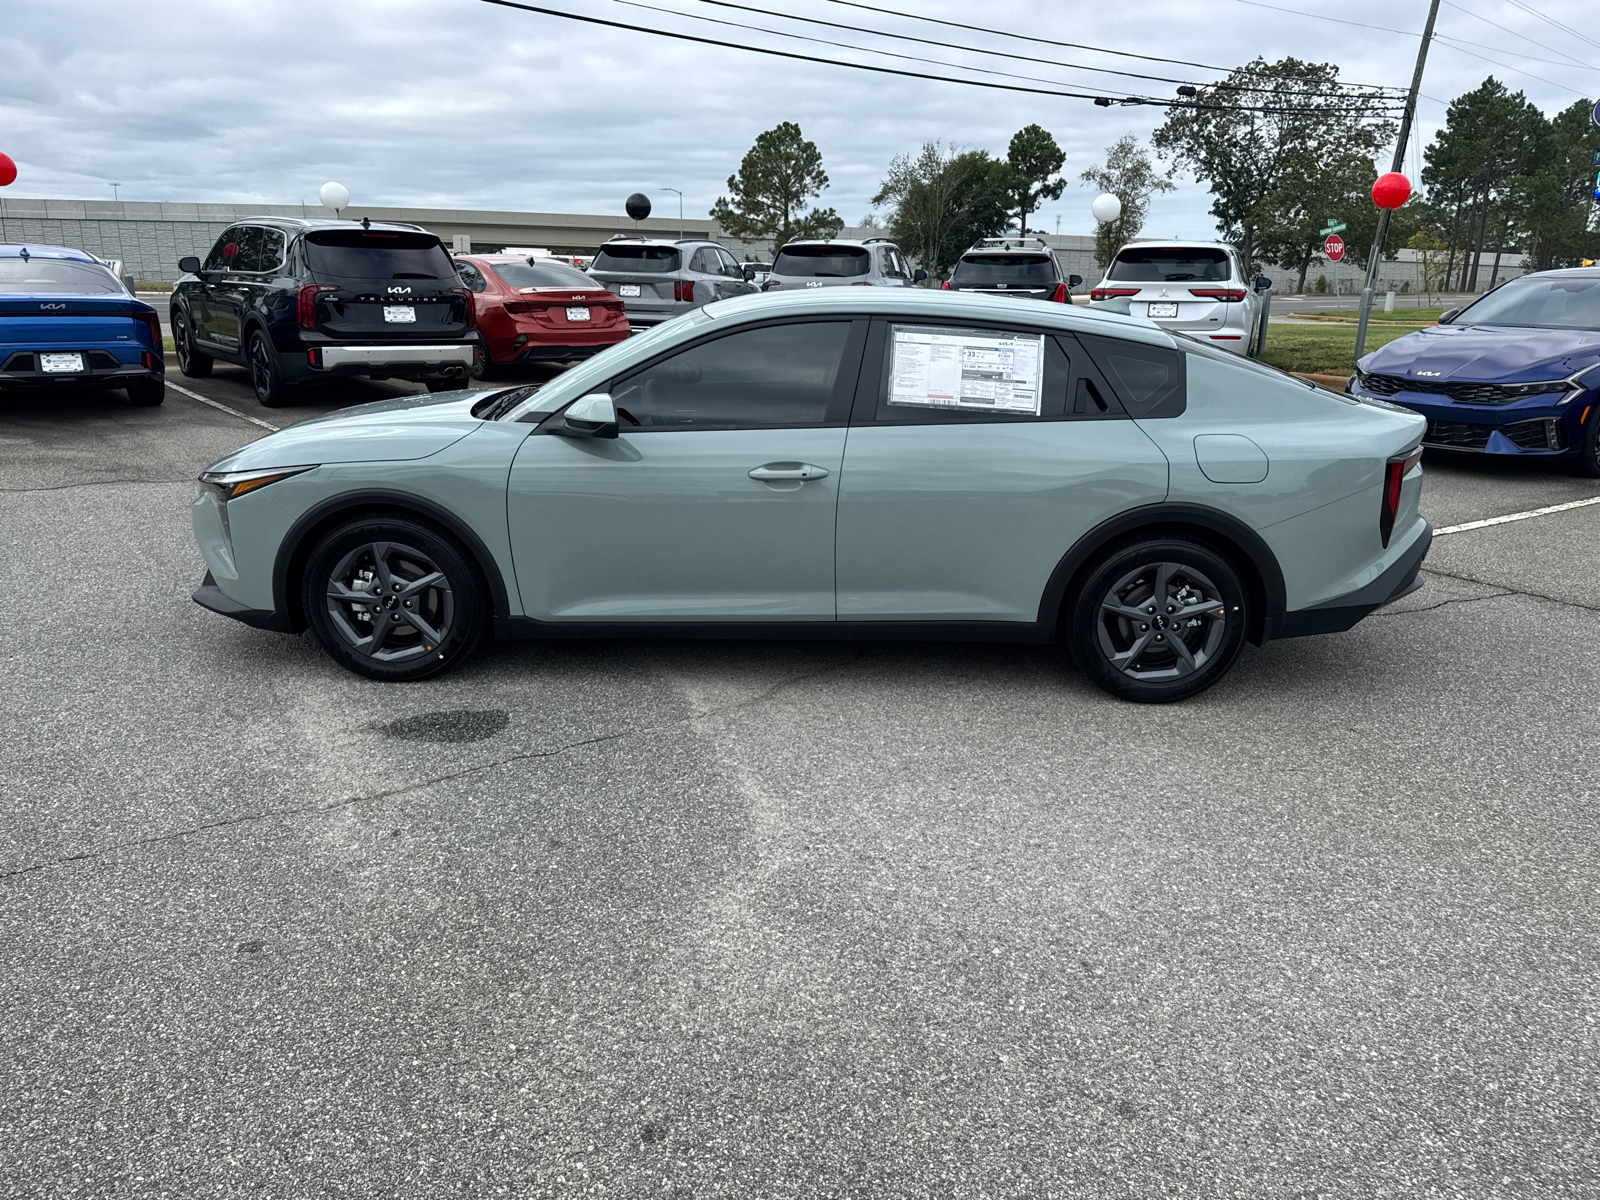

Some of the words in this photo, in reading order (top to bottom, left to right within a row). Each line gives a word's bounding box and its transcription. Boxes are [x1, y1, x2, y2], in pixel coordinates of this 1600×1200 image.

[1326, 243, 1343, 253] STOP
[387, 286, 412, 294] KIA
[386, 595, 397, 609] KIA
[1156, 615, 1165, 630] KIA
